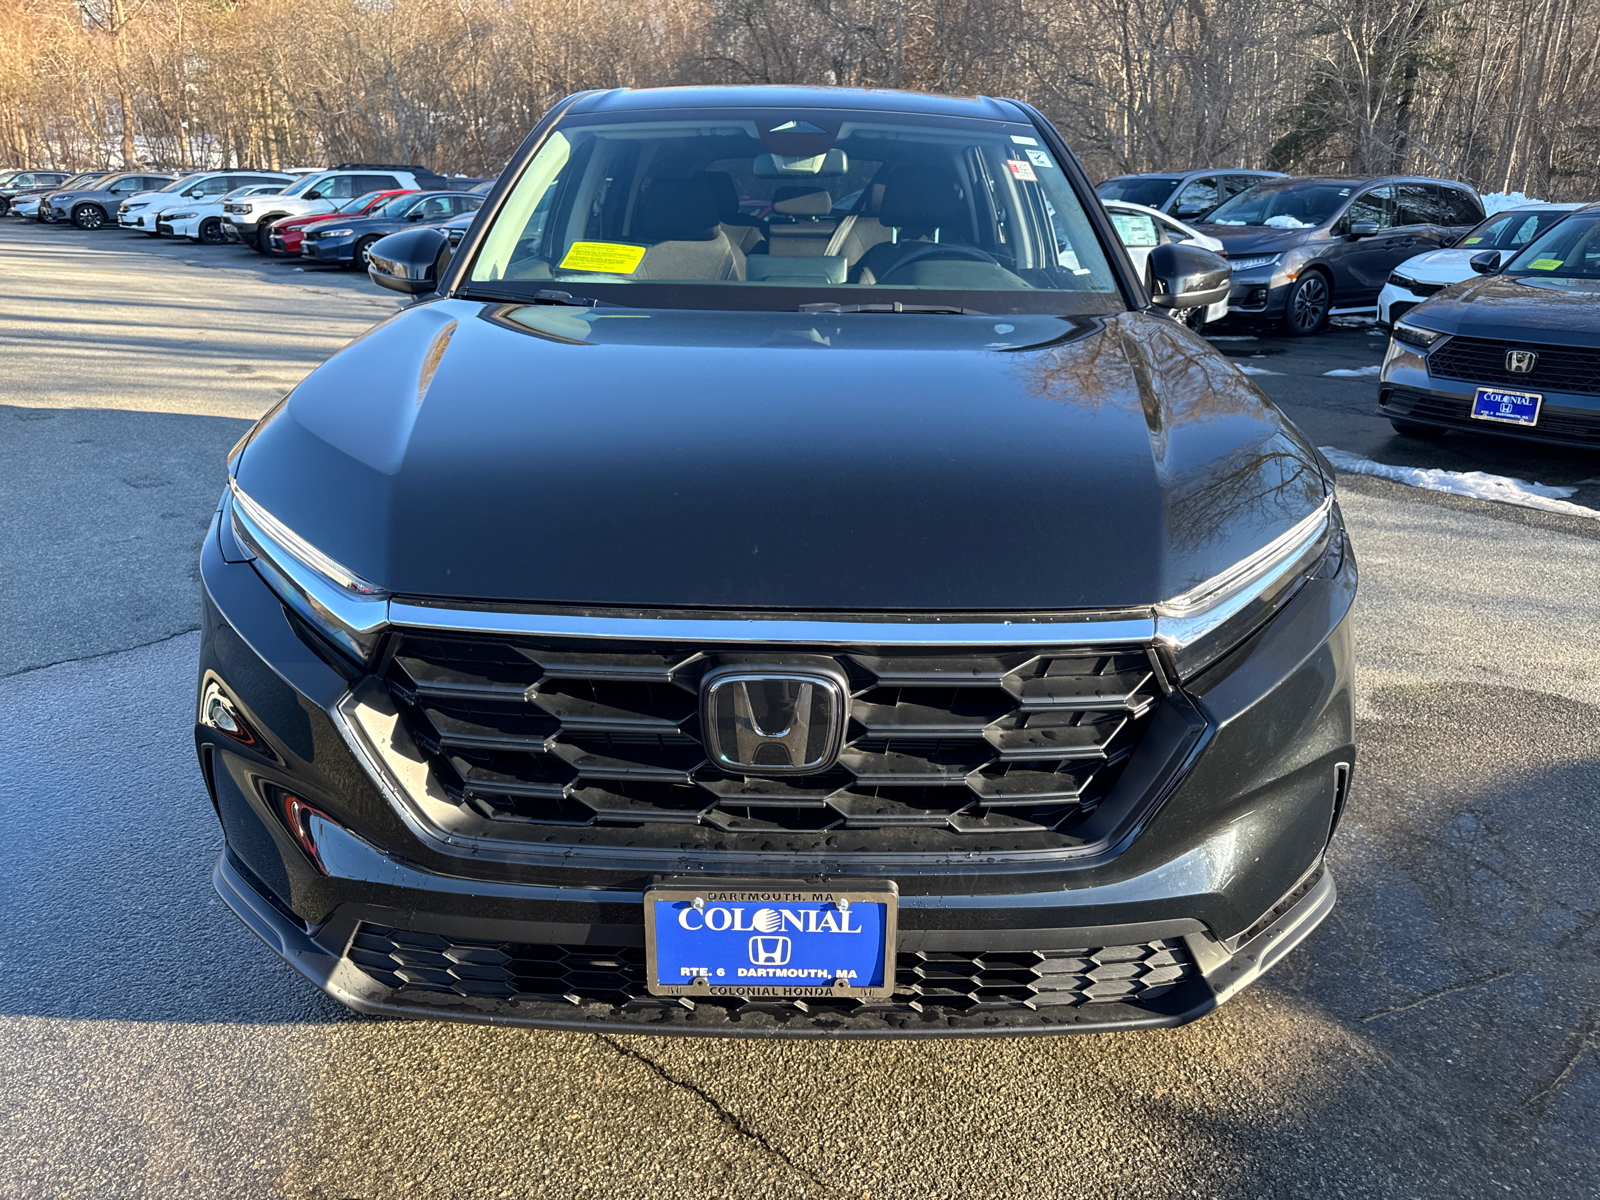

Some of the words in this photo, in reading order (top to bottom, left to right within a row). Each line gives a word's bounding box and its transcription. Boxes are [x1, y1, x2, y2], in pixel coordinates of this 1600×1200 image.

[1484, 393, 1532, 406] COLONIAL
[812, 893, 834, 902] MA
[678, 907, 862, 934] COLONIAL
[680, 967, 713, 977] RTE.
[717, 967, 726, 977] 6
[737, 968, 832, 979] DARTMOUTH,
[835, 969, 858, 979] MA
[709, 986, 779, 996] COLONIAL
[783, 987, 834, 997] HONDA
